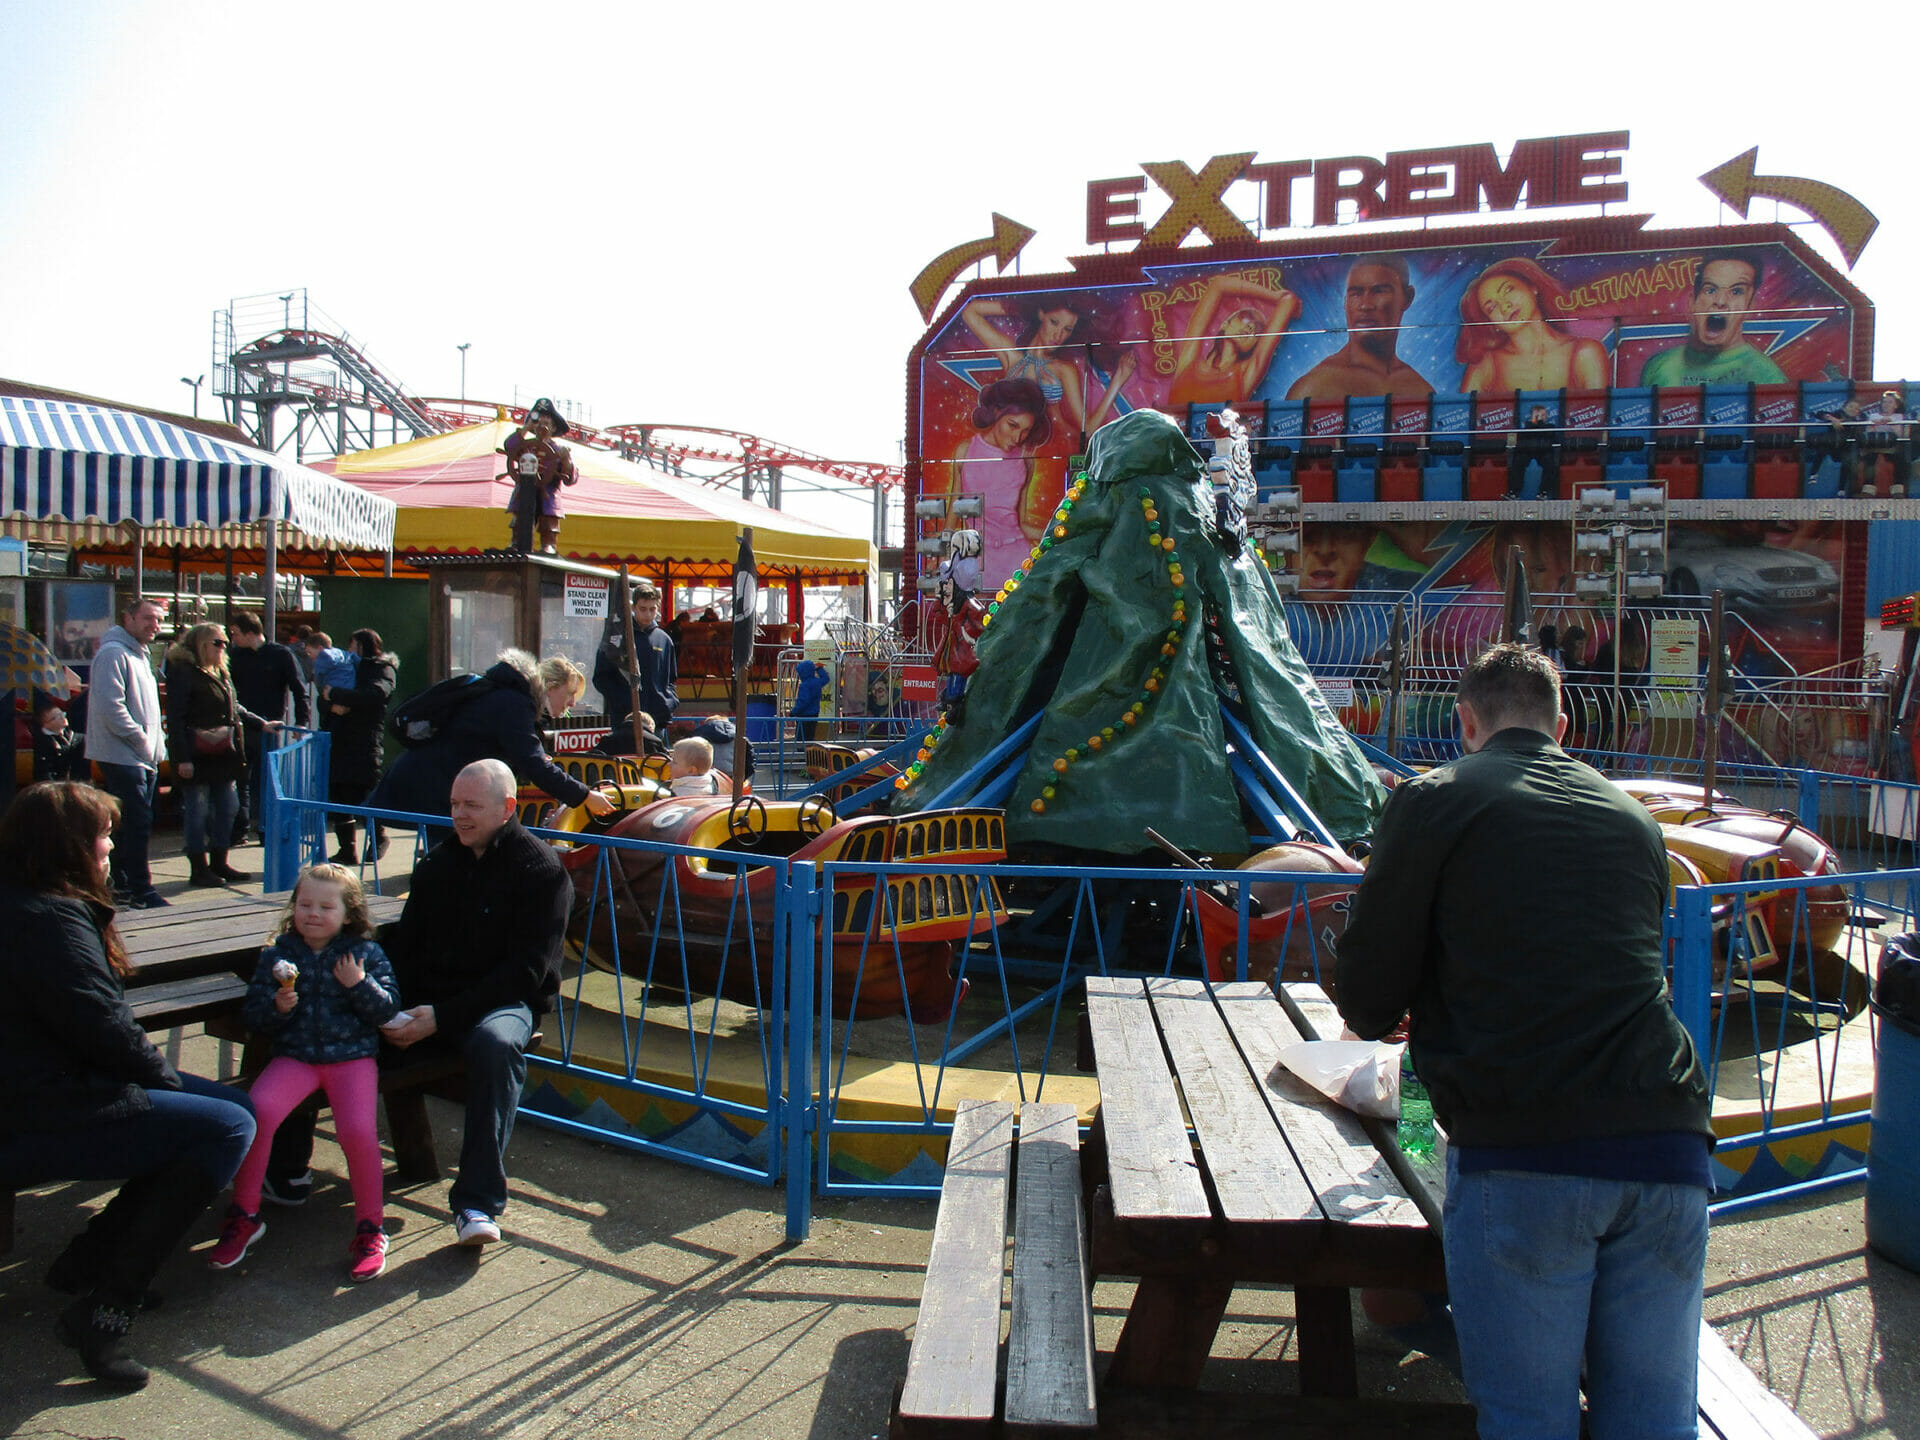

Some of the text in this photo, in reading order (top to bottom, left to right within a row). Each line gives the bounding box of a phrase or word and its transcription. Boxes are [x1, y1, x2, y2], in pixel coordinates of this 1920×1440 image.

[1086, 130, 1630, 249] EXTREME
[1141, 267, 1284, 312] DANER
[570, 576, 605, 588] CAUTION
[568, 591, 606, 600] STAND CLEAR
[572, 599, 601, 608] WHILST IN
[575, 608, 598, 616] MOTION
[903, 679, 936, 689] ENTRANCE
[558, 733, 607, 750] NOTIC
[652, 806, 696, 828] 6
